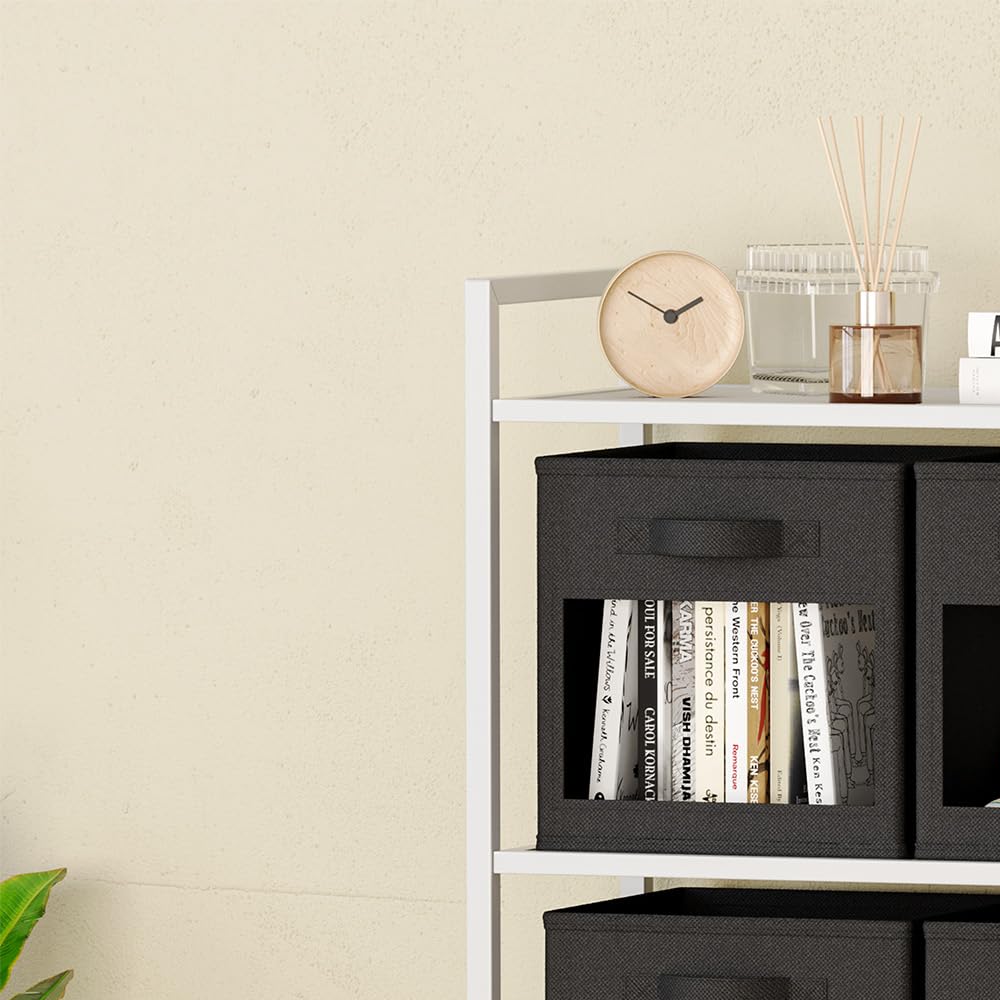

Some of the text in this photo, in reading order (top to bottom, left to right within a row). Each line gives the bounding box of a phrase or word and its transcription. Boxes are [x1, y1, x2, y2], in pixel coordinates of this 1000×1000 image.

[607, 632, 616, 648] the
[644, 625, 656, 648] FOR
[732, 617, 741, 665] Western
[750, 617, 759, 635] THE
[800, 621, 812, 645] Over
[603, 649, 616, 691] Willows
[644, 650, 656, 679] SALE
[750, 639, 759, 683] CUCKOO'S
[802, 650, 816, 671] The
[702, 606, 718, 756] persistance du destin
[732, 668, 741, 699] Front
[680, 600, 693, 801] KARMA VISH DHAMIJA
[750, 686, 759, 710] NEST
[804, 674, 820, 724] Cuckoo's
[599, 708, 611, 741] Kenneth
[644, 707, 656, 746] CAROL
[808, 728, 822, 753] Nest
[644, 749, 656, 801] KORNAC
[731, 744, 739, 790] Remarque
[750, 755, 759, 776] KEN
[812, 757, 821, 779] Ken
